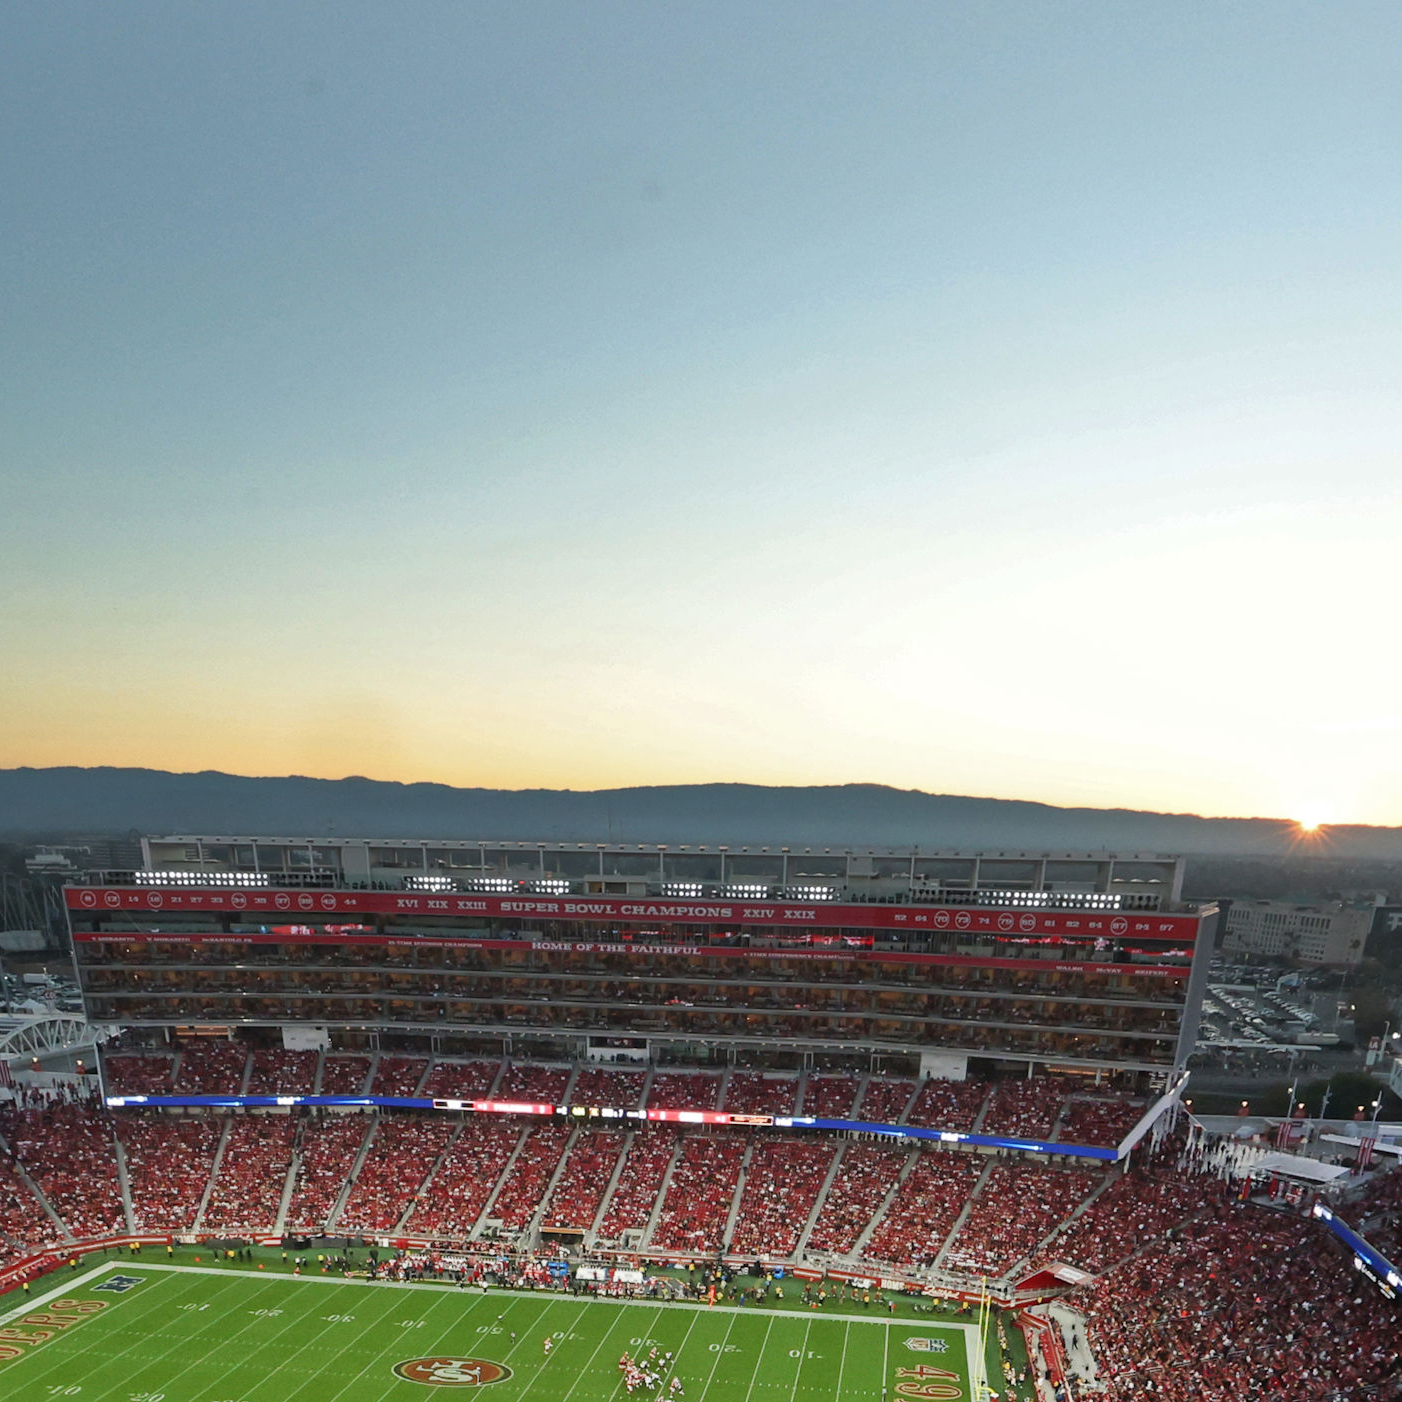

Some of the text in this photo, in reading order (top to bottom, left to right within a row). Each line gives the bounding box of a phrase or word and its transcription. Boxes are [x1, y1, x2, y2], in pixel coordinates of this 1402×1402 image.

[397, 899, 418, 908] XVI
[428, 900, 448, 909] XIX
[457, 900, 487, 910] XXIII
[500, 901, 733, 918] SUPER BOWL CHAMPIONS
[743, 908, 775, 919] XXIV
[783, 909, 816, 920] XXIX
[532, 942, 702, 955] HOME OF THE FAITHFUL
